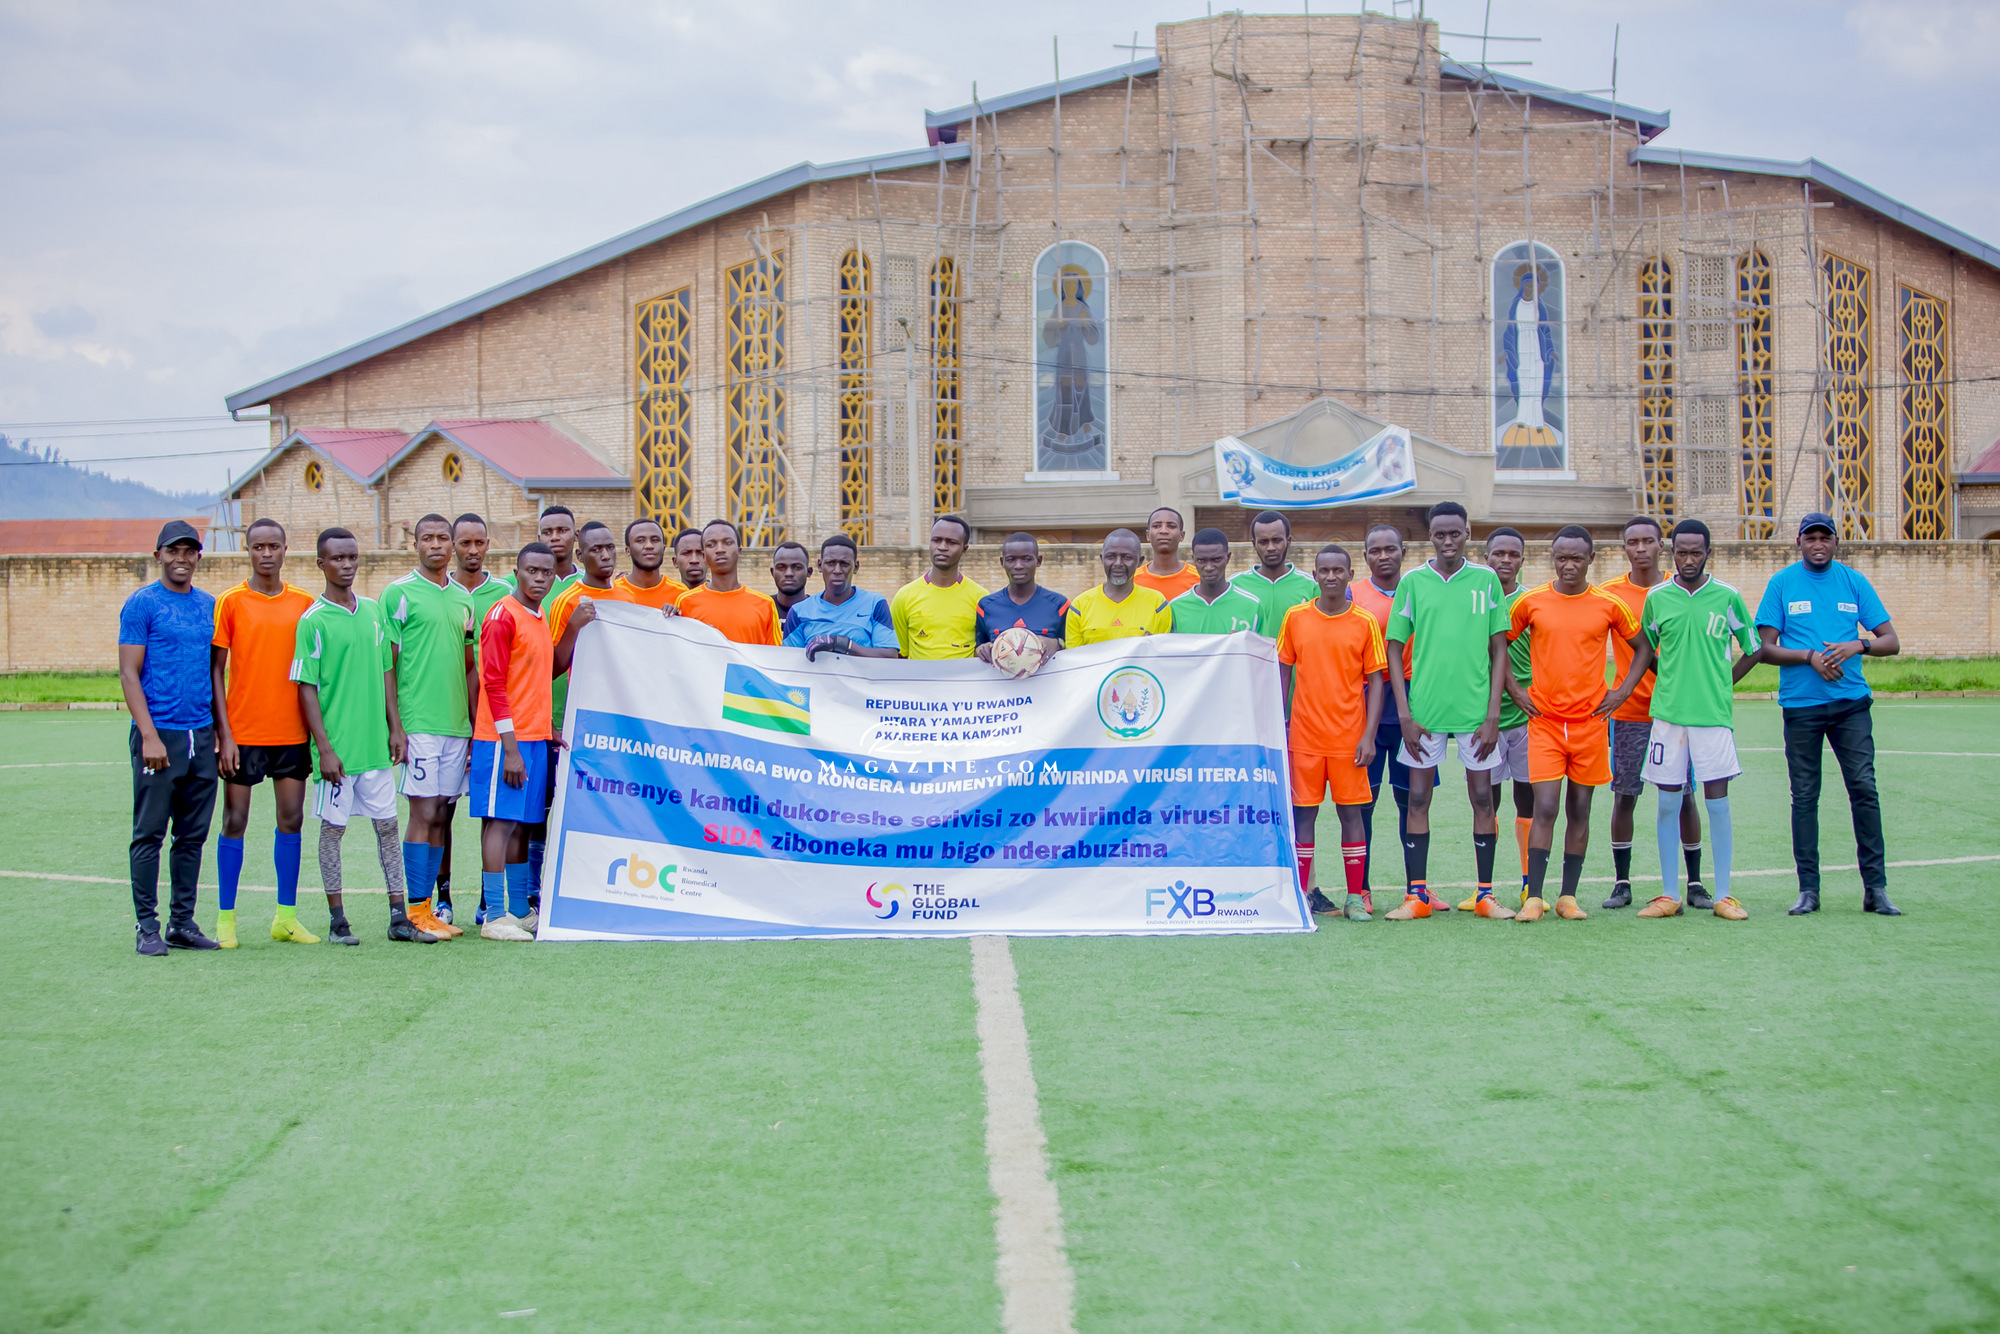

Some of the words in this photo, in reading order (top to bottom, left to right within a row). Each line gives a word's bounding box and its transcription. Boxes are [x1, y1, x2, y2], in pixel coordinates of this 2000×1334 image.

[1263, 462, 1309, 478] Kubera
[1470, 589, 1486, 615] 11
[1706, 611, 1727, 639] 10
[866, 698, 949, 712] REPUBULIKA
[952, 701, 973, 711] Y'U
[976, 696, 1033, 710] RWANDA
[880, 715, 927, 727] INTARA
[930, 712, 1019, 726] Y'AMAJYEPFO
[941, 731, 959, 741] KA
[1649, 740, 1665, 766] 10
[413, 757, 427, 781] 5
[583, 733, 767, 775] UBUKANGURAMBAGA
[771, 764, 813, 783] BWO
[817, 771, 905, 794] KONGERA
[910, 774, 1002, 795] UBUMENYI
[1007, 771, 1034, 786] MU
[1038, 769, 1129, 785] KWIRINDA
[1133, 767, 1193, 783] VIRUSI
[1198, 767, 1249, 782] ITERA
[574, 769, 683, 805] Tumenye
[689, 788, 760, 815] kandi
[766, 799, 904, 827] dukoreshe
[910, 808, 1003, 828] serivisi
[1008, 811, 1036, 827] zo
[1044, 805, 1152, 827] kwirinda
[1160, 804, 1230, 825] virusi
[1238, 804, 1283, 826] itera
[703, 823, 764, 848] SIDA
[770, 831, 888, 859] ziboneka
[896, 843, 934, 860] mu
[941, 841, 996, 864] bigo
[1003, 838, 1168, 860] nderabuzima
[607, 853, 678, 893] rbc
[682, 865, 708, 875] Rwanda
[681, 877, 717, 888] Biomedical
[912, 883, 945, 895] THE
[680, 888, 702, 897] Centre
[912, 897, 980, 909] GLOBAL
[1146, 885, 1216, 919] FXB
[912, 910, 958, 920] FUND
